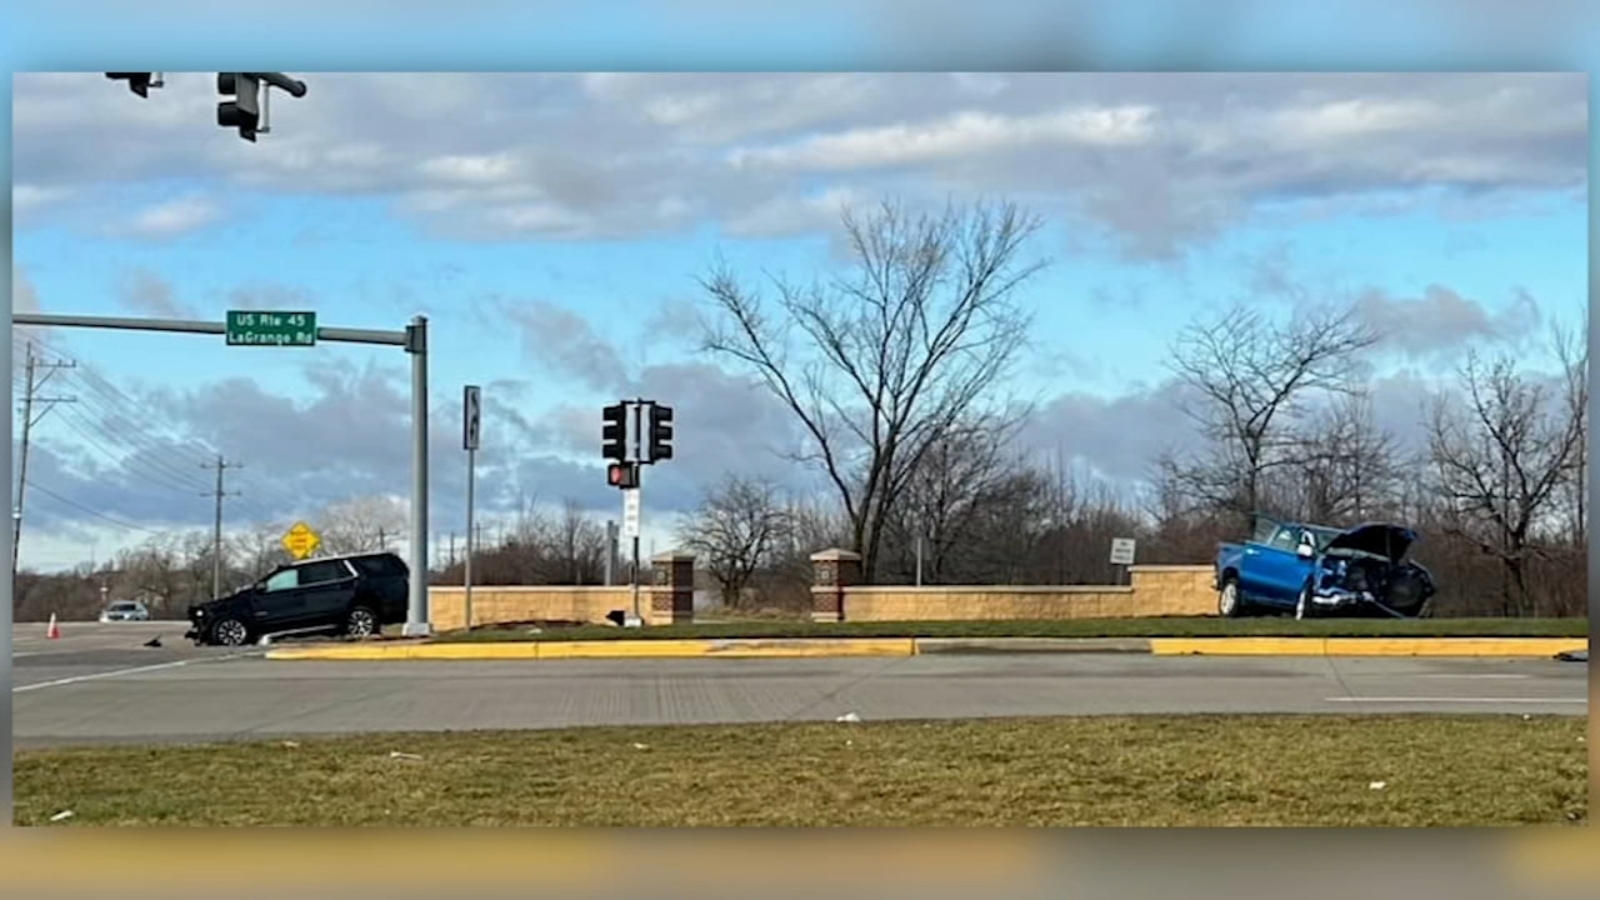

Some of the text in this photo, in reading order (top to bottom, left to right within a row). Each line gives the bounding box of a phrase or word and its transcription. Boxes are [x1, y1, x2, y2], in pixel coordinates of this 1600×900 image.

[236, 314, 255, 326] US
[287, 314, 305, 327] 45
[229, 331, 312, 345] LaGrange Rd
